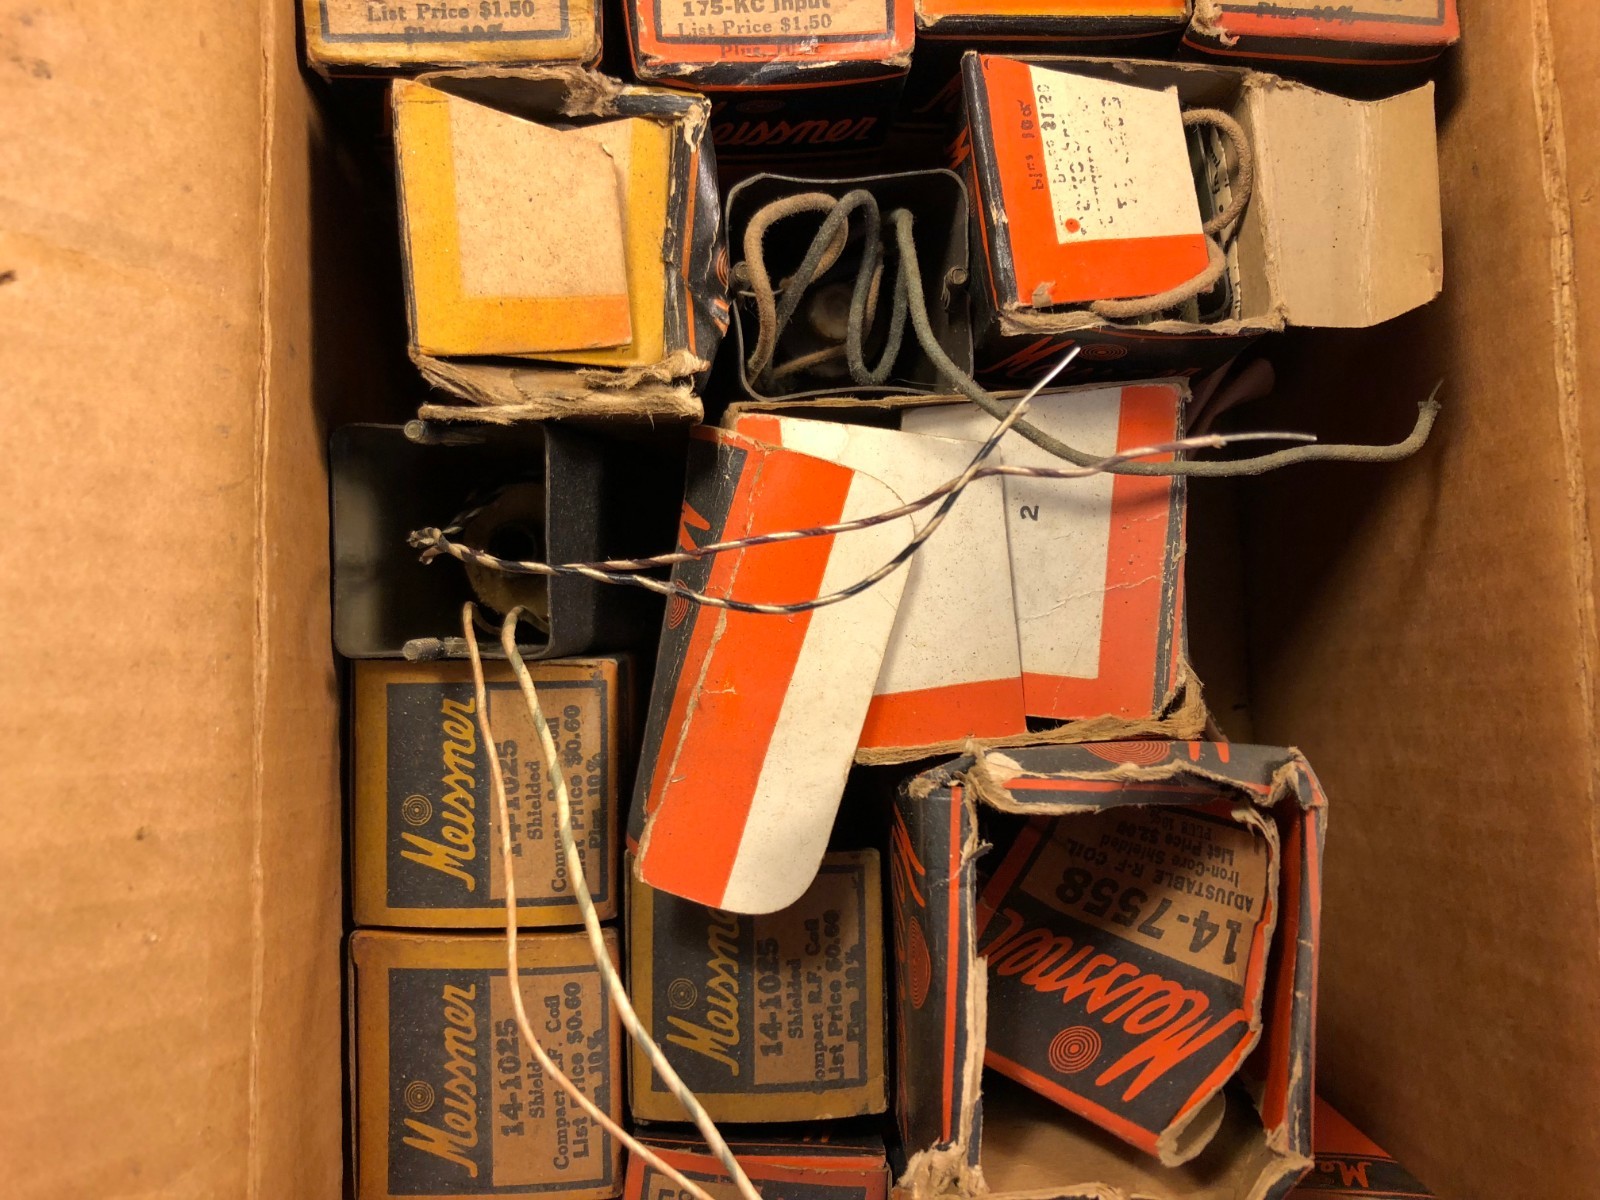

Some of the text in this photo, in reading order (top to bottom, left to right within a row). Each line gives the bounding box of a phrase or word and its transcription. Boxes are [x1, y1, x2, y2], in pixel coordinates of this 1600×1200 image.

[367, 5, 407, 22] List
[416, 3, 469, 20] Price
[677, 14, 832, 38] List Price $1.50
[710, 101, 880, 147] eissner
[1020, 504, 1040, 522] 2
[400, 697, 477, 893] Meissner
[526, 760, 544, 841] Shielded
[567, 774, 586, 831] Price
[1172, 855, 1240, 888] Iron-Core
[1206, 842, 1235, 866] List
[1055, 867, 1243, 966] 14-7558
[1153, 868, 1254, 914] ADJUSTABLE
[666, 909, 741, 1077] Meissn
[757, 937, 784, 1057] 14-1025
[826, 978, 845, 1038] Price
[984, 907, 1251, 1102] Meissner
[403, 983, 479, 1178] Meissner
[495, 1017, 525, 1137] 14-1025
[526, 1039, 546, 1119] Shield
[553, 1089, 570, 1170] Compact
[572, 1115, 590, 1159] List
